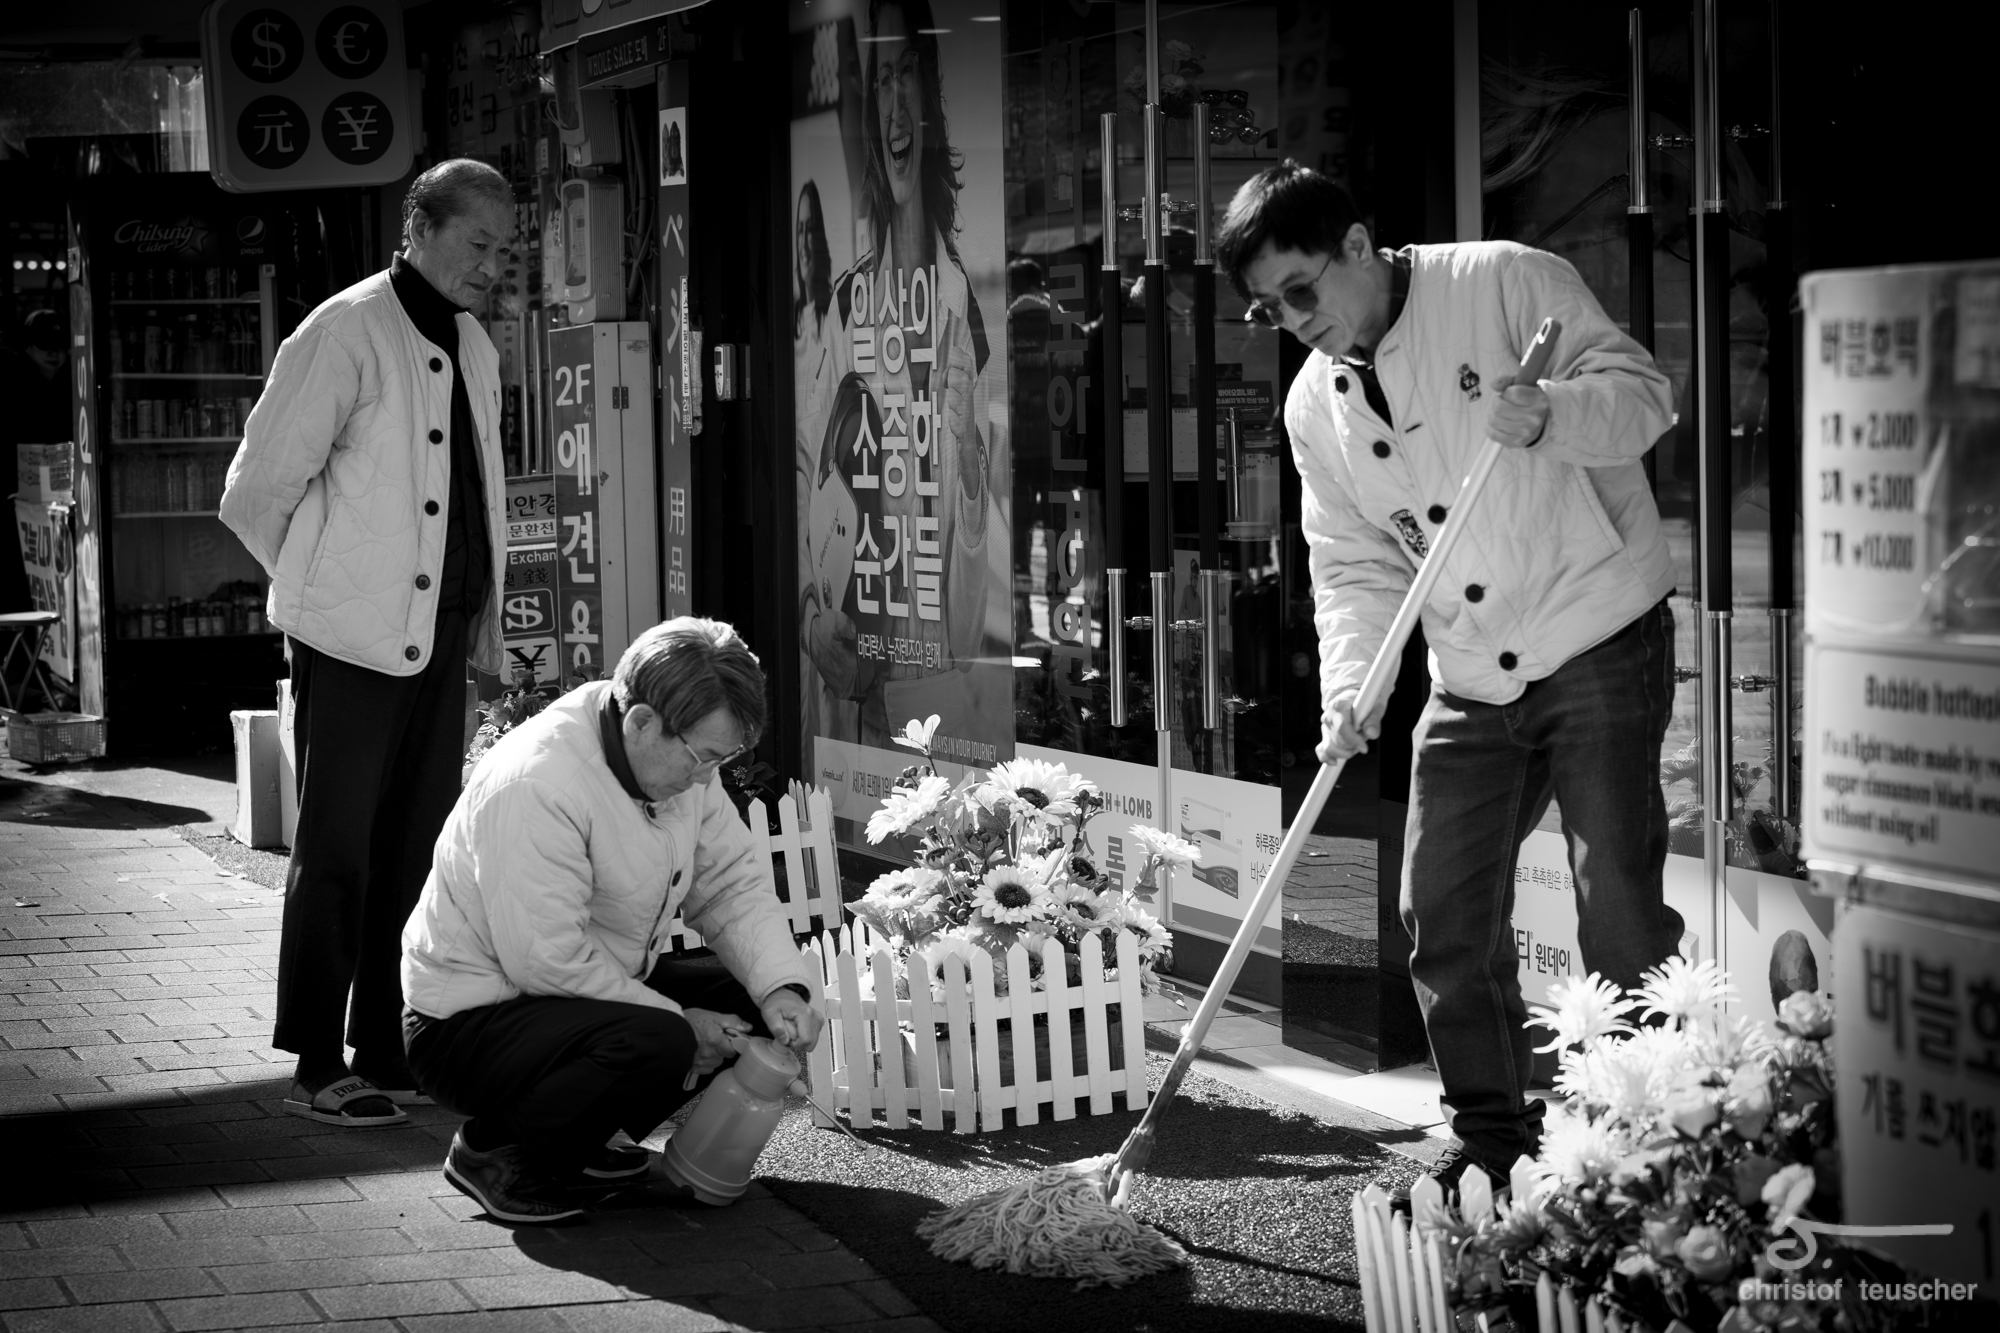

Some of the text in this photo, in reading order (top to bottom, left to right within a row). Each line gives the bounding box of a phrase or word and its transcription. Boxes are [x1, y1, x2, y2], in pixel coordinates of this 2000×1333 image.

[586, 48, 613, 78] WHOLE
[613, 41, 634, 70] SALE
[656, 25, 667, 52] 2F
[253, 111, 295, 155] 元
[113, 219, 196, 249] Chilsung
[136, 240, 170, 254] Cider
[240, 246, 265, 256] pepsi
[850, 265, 938, 375] 일상의
[555, 363, 591, 407] 2F
[663, 214, 686, 598] ペット用品
[852, 390, 942, 498] 소중한
[509, 550, 556, 566] Exchan
[556, 423, 600, 666] 애견용
[854, 512, 943, 622] 순간들
[925, 641, 942, 670] 함께
[1865, 675, 1928, 712] Bubble
[948, 737, 955, 755] IN
[955, 738, 971, 759] YOUR
[971, 741, 997, 763] JOURNEY
[852, 770, 895, 799] 세계 판매 1위
[1531, 866, 1562, 891] 촉촉함은
[1535, 943, 1571, 977] 원데이
